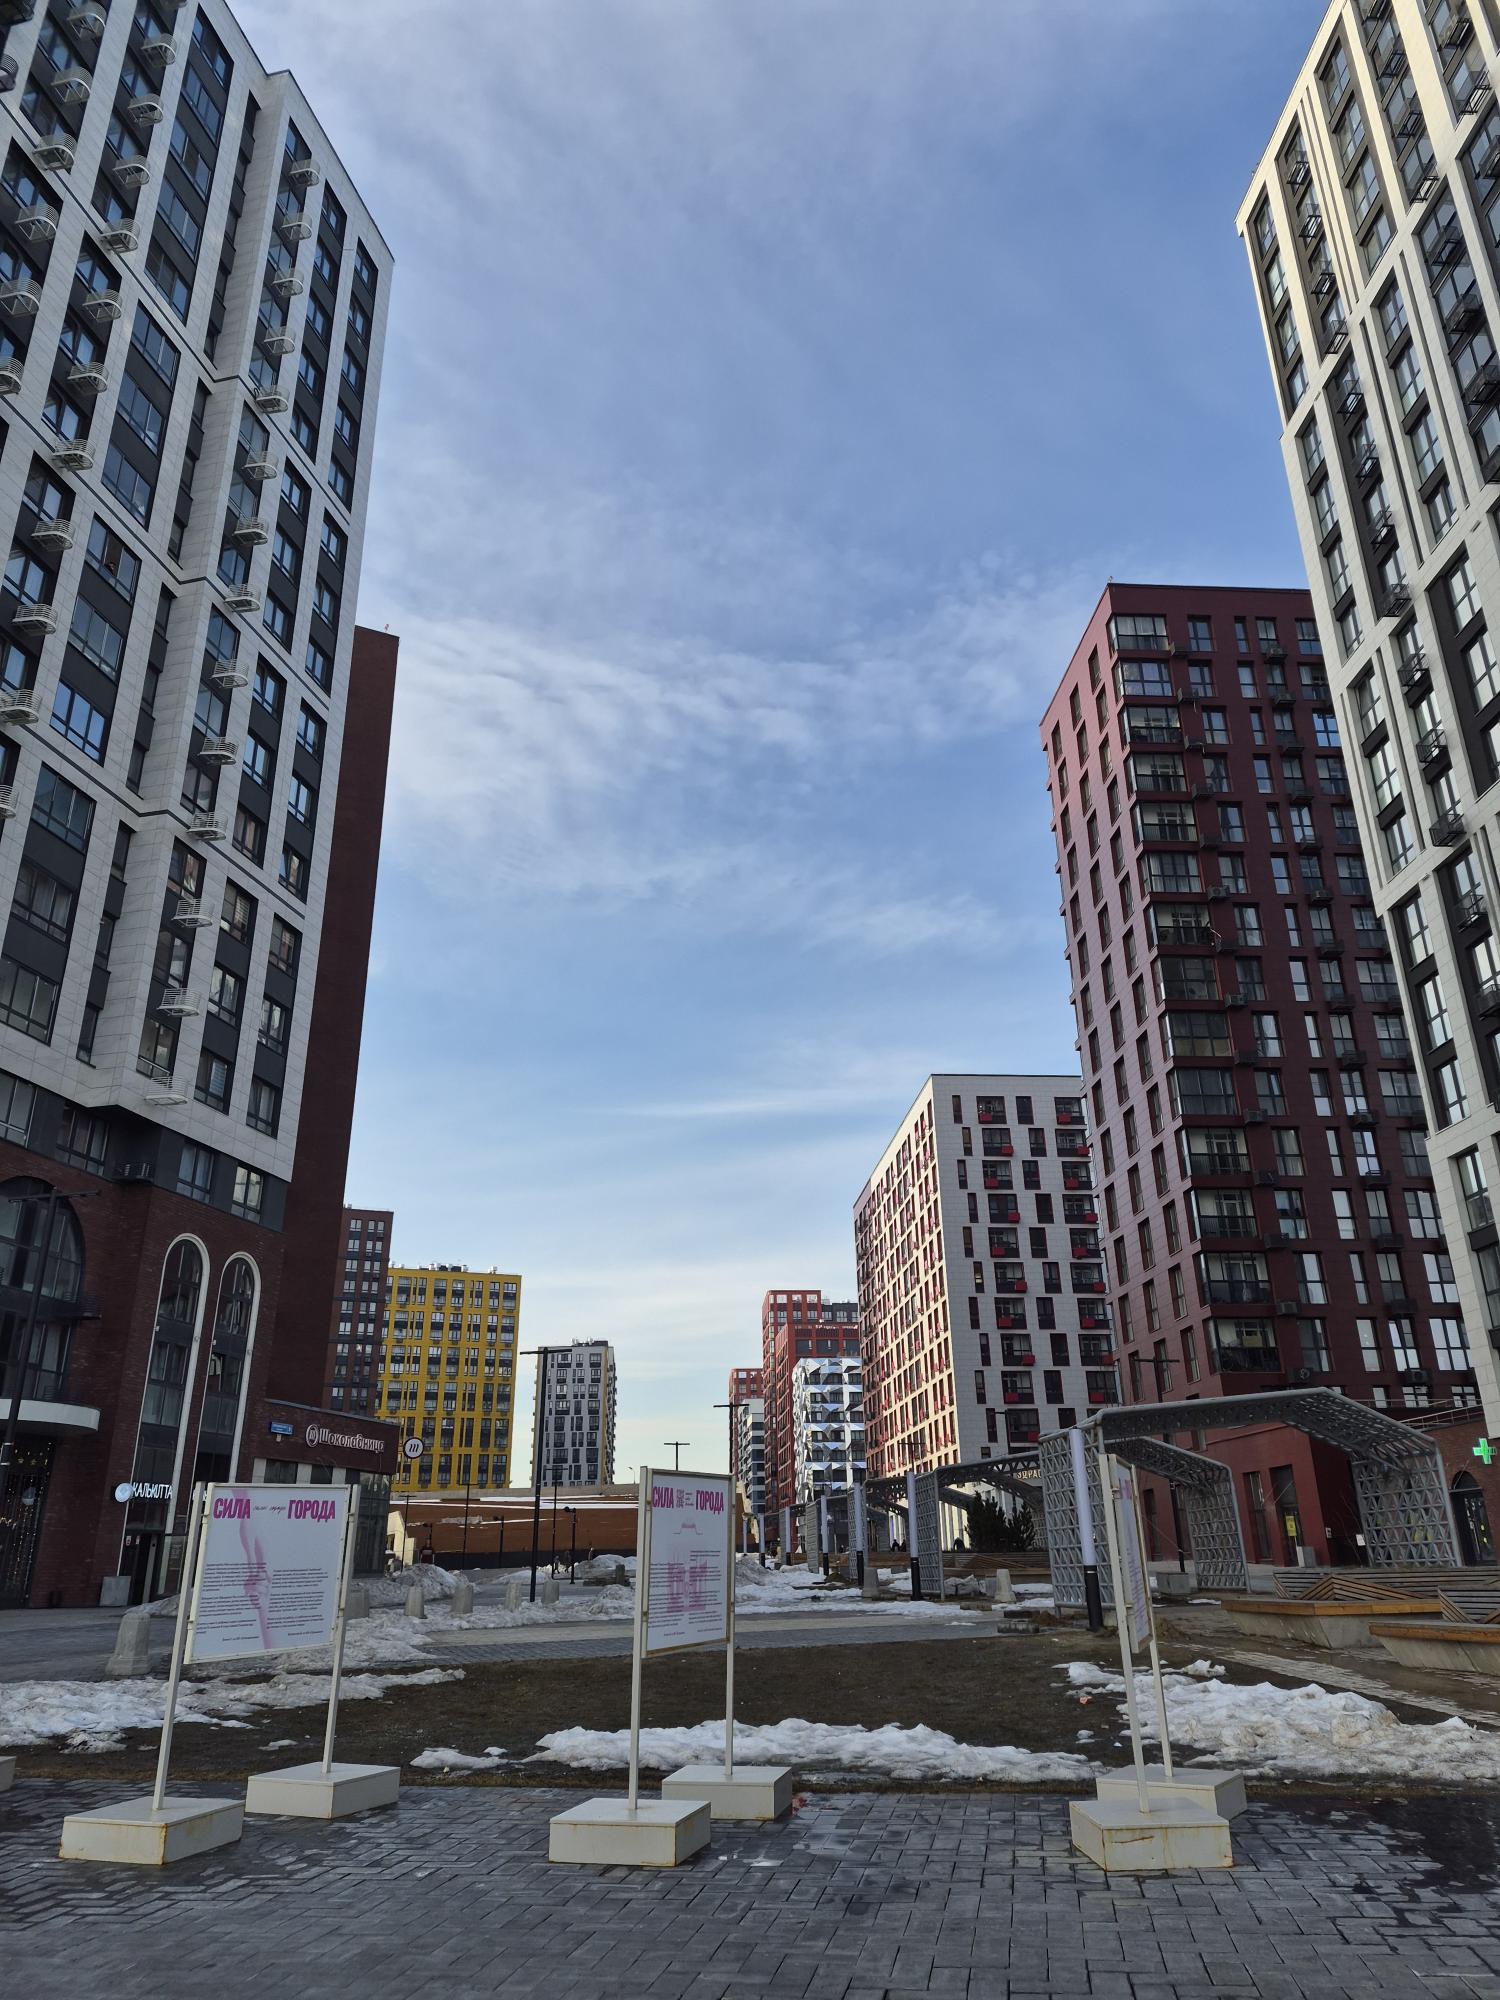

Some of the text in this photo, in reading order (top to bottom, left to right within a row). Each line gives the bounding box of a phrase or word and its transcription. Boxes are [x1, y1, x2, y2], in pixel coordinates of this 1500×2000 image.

[319, 1428, 384, 1453] Шоколадница
[213, 1498, 252, 1519] СИЛА
[287, 1500, 336, 1522] ГОРОДА
[652, 1486, 674, 1508] СИЛА
[696, 1490, 724, 1515] ГОРОДА
